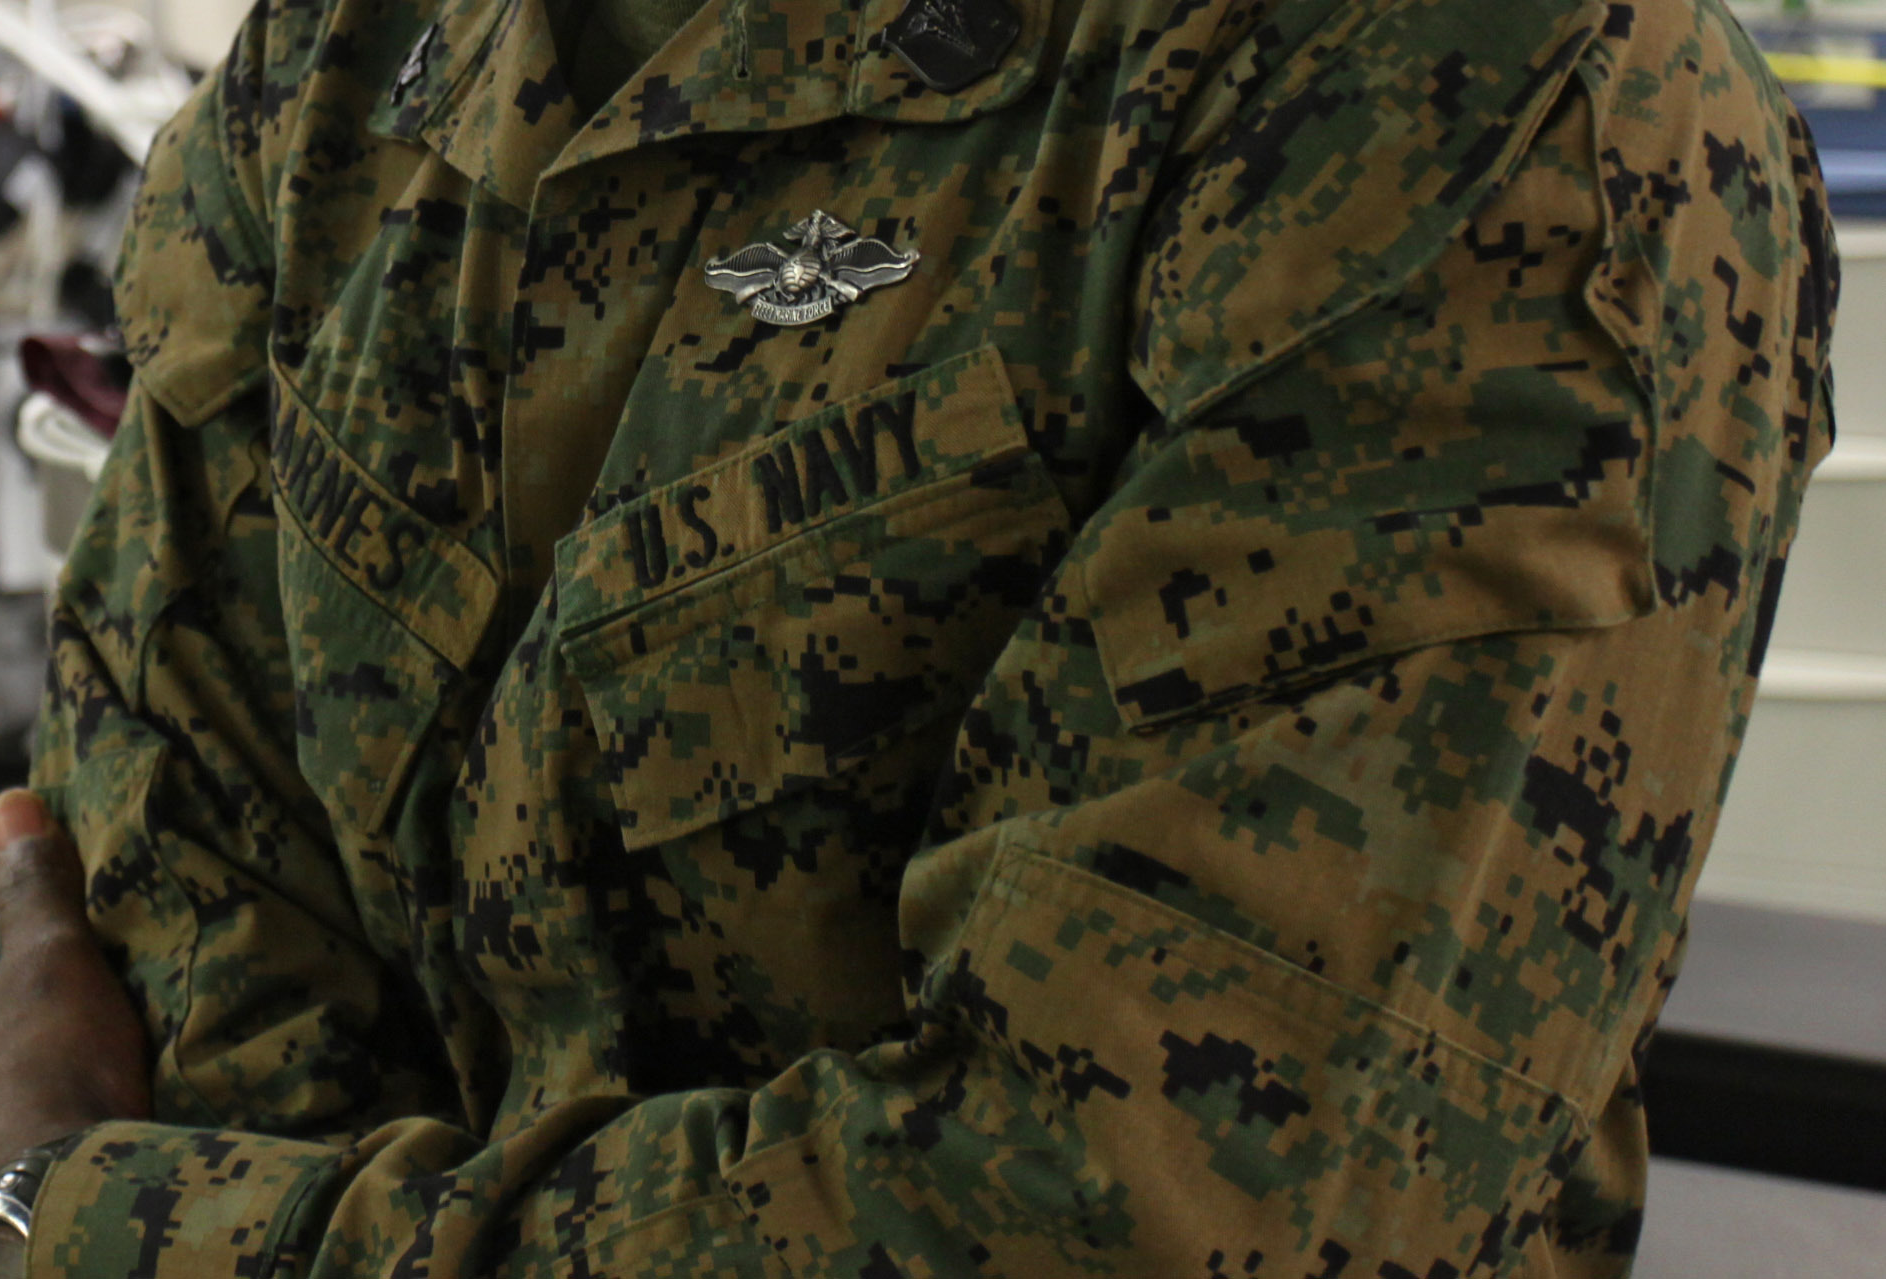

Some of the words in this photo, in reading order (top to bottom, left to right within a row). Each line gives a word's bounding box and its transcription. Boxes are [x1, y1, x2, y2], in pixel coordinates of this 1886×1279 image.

[804, 301, 830, 320] FORCE
[270, 380, 425, 592] ARNES
[625, 484, 735, 589] U.S.
[754, 389, 921, 534] NAVY
